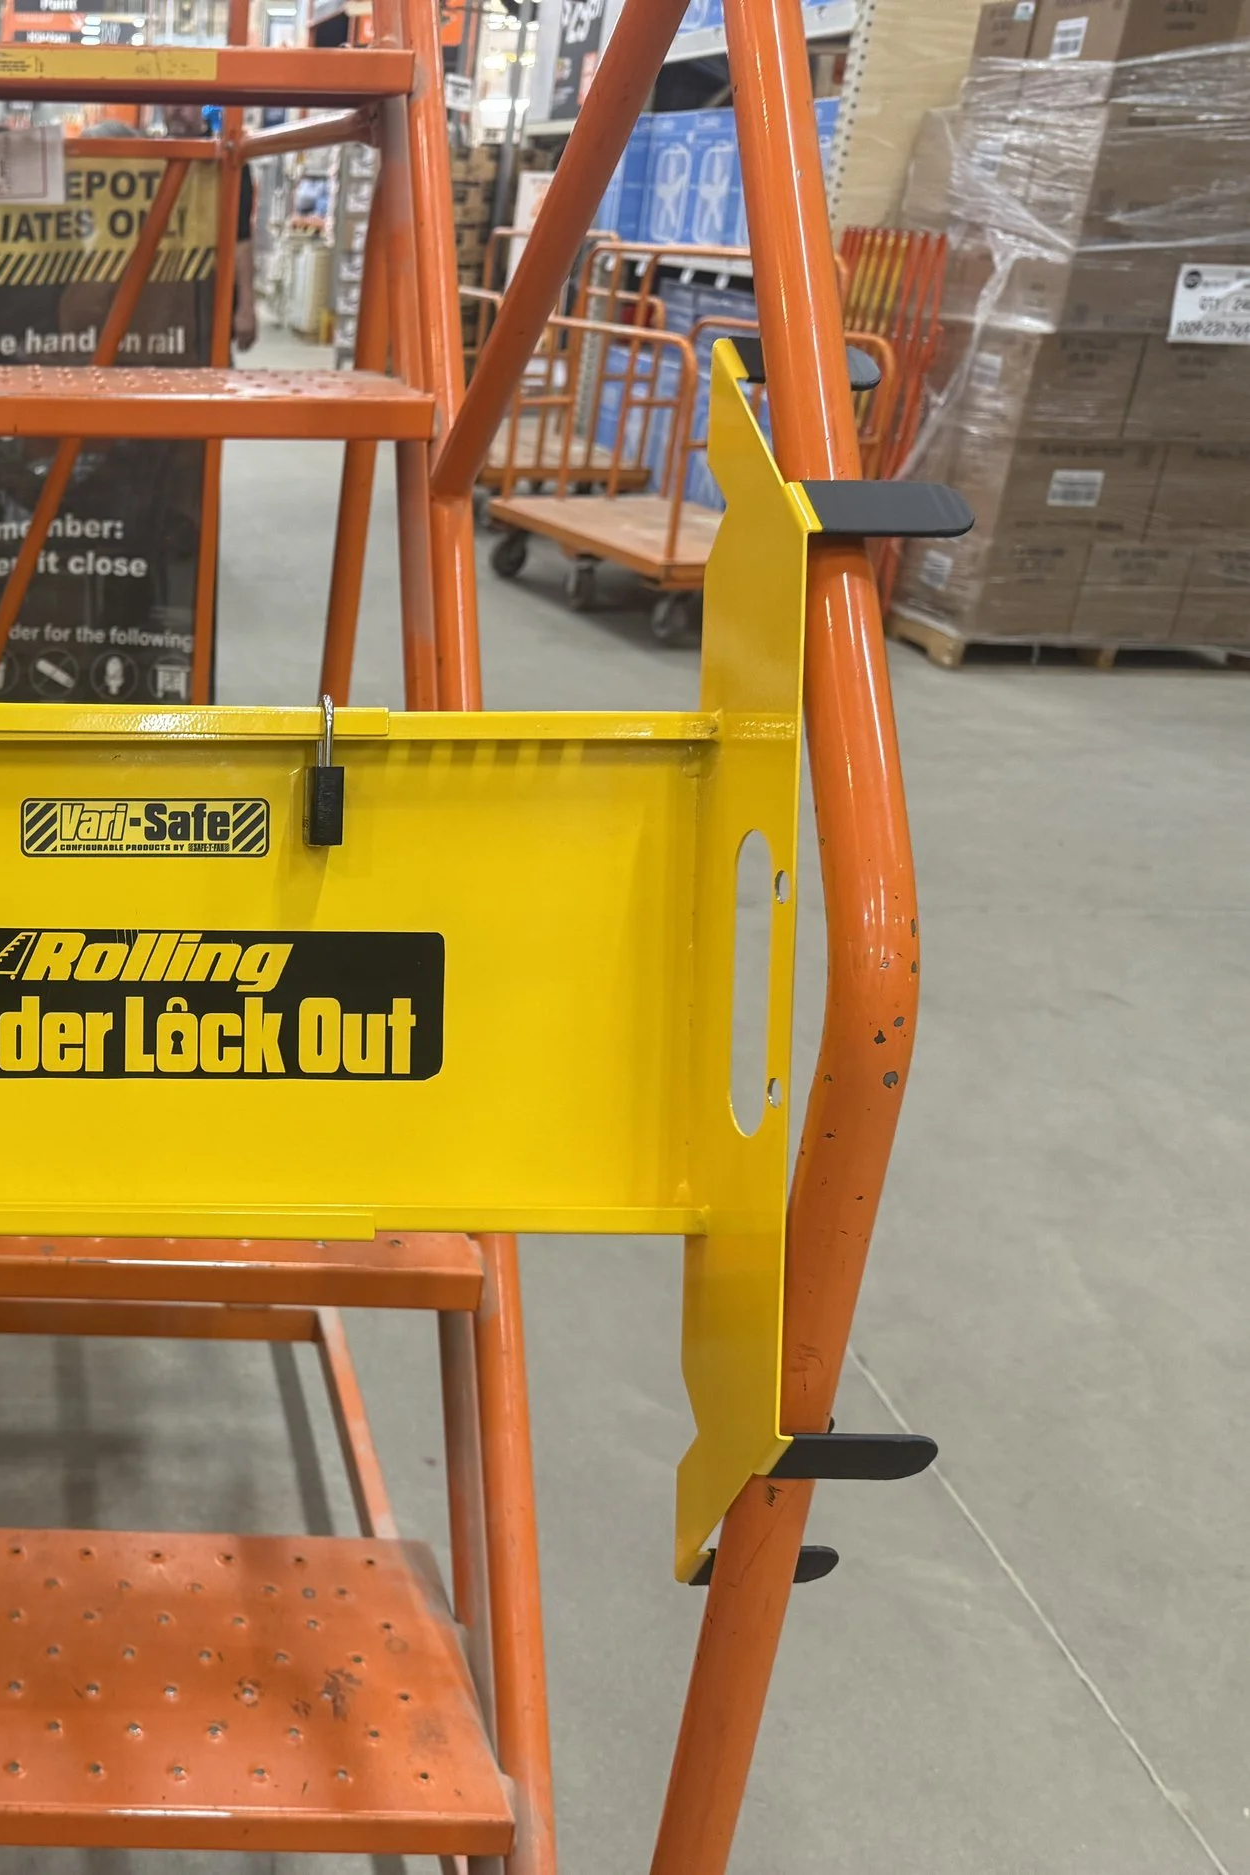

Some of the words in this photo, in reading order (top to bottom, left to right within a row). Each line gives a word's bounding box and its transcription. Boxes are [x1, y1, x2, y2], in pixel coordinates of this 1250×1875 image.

[24, 326, 97, 354] hand
[37, 550, 59, 574] it
[67, 551, 148, 577] close
[44, 623, 72, 642] for
[75, 623, 105, 644] the
[59, 803, 230, 842] Vari-Safe
[60, 843, 124, 852] CONFIGURABLE
[125, 843, 171, 852] PRODUCTS
[173, 843, 185, 852] BY
[20, 931, 294, 993] Rolling
[123, 996, 285, 1074] Lock
[297, 996, 418, 1075] Out
